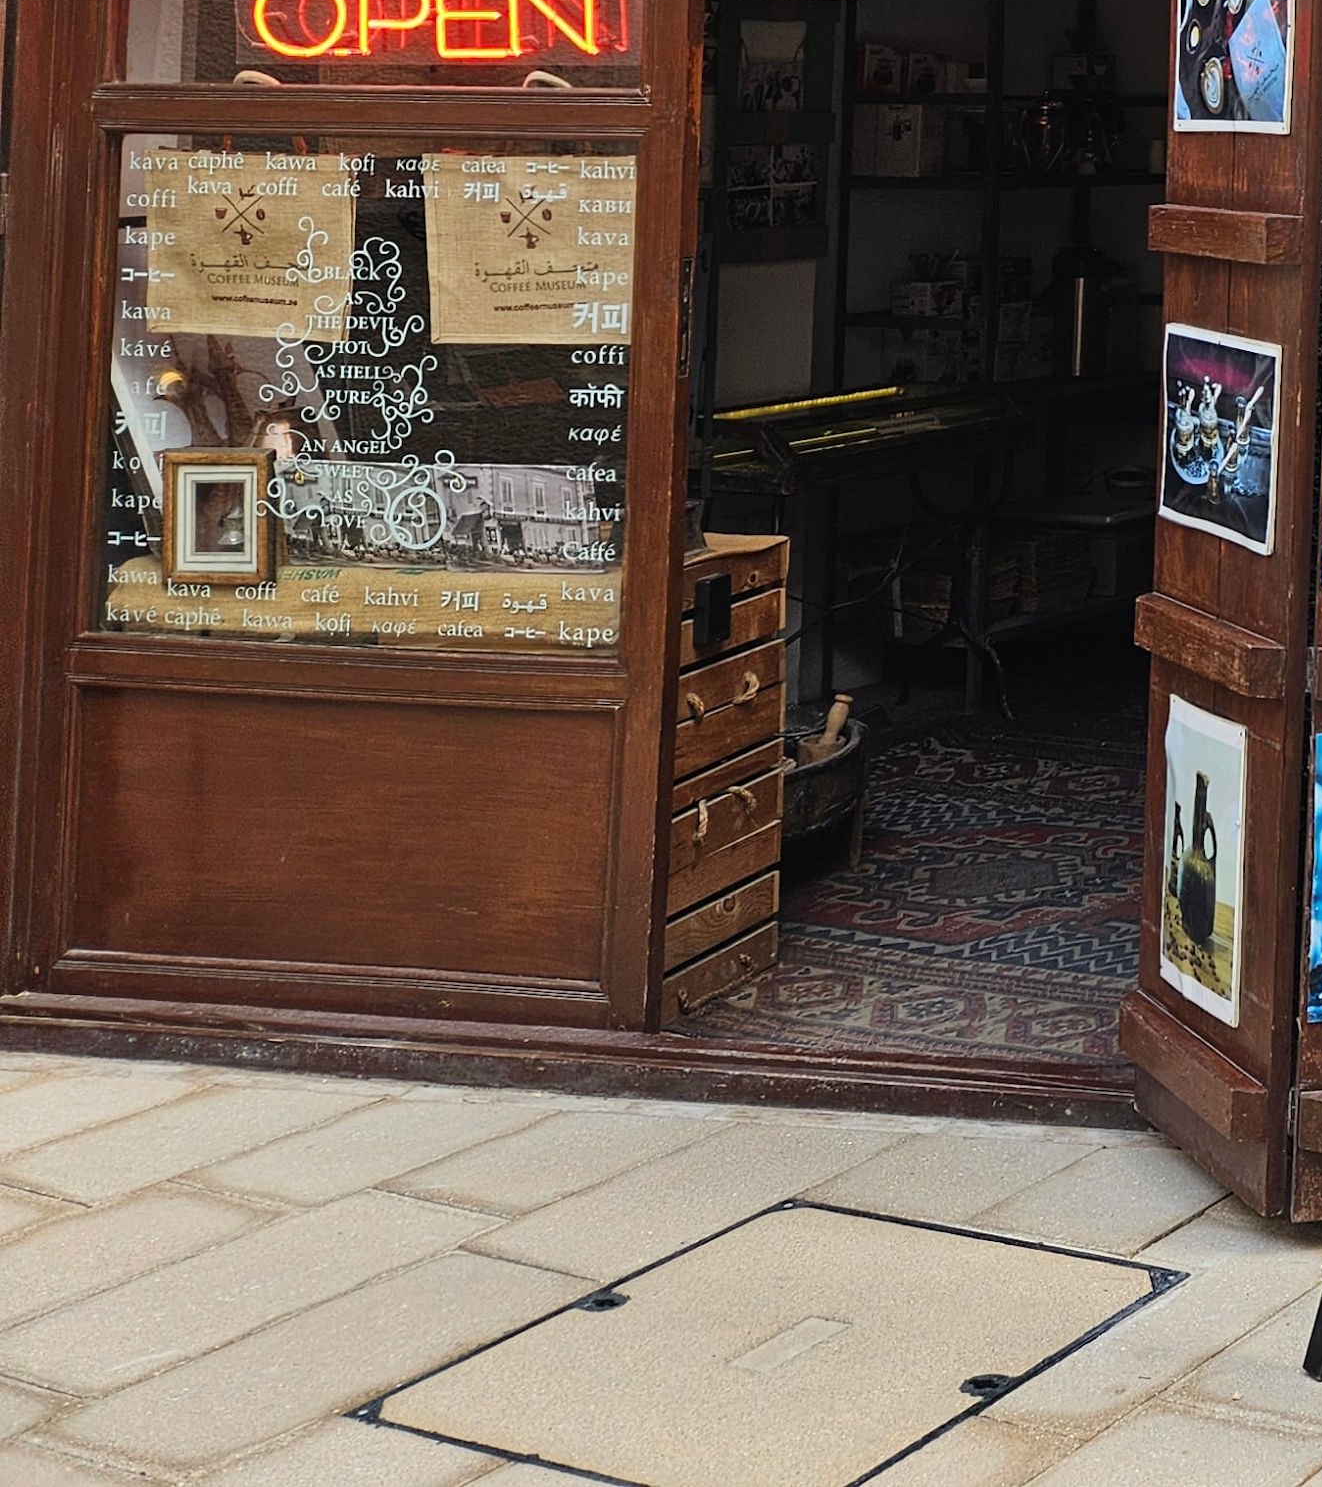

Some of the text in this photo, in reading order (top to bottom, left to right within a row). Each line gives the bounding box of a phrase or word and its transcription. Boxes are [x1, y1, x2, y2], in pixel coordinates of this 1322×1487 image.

[129, 151, 179, 171] kava
[265, 151, 317, 171] kawa
[461, 157, 507, 175] cafea
[579, 160, 636, 180] kahvi
[187, 175, 232, 195] kava
[256, 177, 298, 196] coffi
[321, 179, 361, 197] café
[384, 178, 440, 199] kahvi
[126, 189, 177, 208] coffi
[124, 226, 176, 251] kape
[576, 226, 630, 247] kava
[324, 266, 382, 281] BLACK
[575, 266, 630, 291] kape
[120, 300, 172, 320] kawa
[571, 301, 630, 336] 커피
[304, 315, 398, 331] THE DEVIL
[119, 338, 172, 358] kávé
[332, 340, 369, 355] HOT
[570, 345, 625, 365] coffi
[316, 364, 384, 380] AS HELL
[325, 389, 372, 405] PURE
[300, 439, 391, 454] AN ANGEL
[566, 462, 618, 483] cafea
[331, 489, 353, 503] AS
[563, 501, 621, 521] kahvi
[320, 514, 367, 529] LOVE
[106, 530, 162, 548] コーヒー
[106, 564, 158, 584] kawa
[166, 578, 212, 598] kava
[234, 582, 277, 600] coffi
[301, 586, 341, 604] café
[363, 585, 419, 607] kahvi
[559, 581, 615, 602] kava
[241, 609, 294, 629] kawa
[437, 619, 484, 638] cafea
[558, 620, 615, 648] kape
